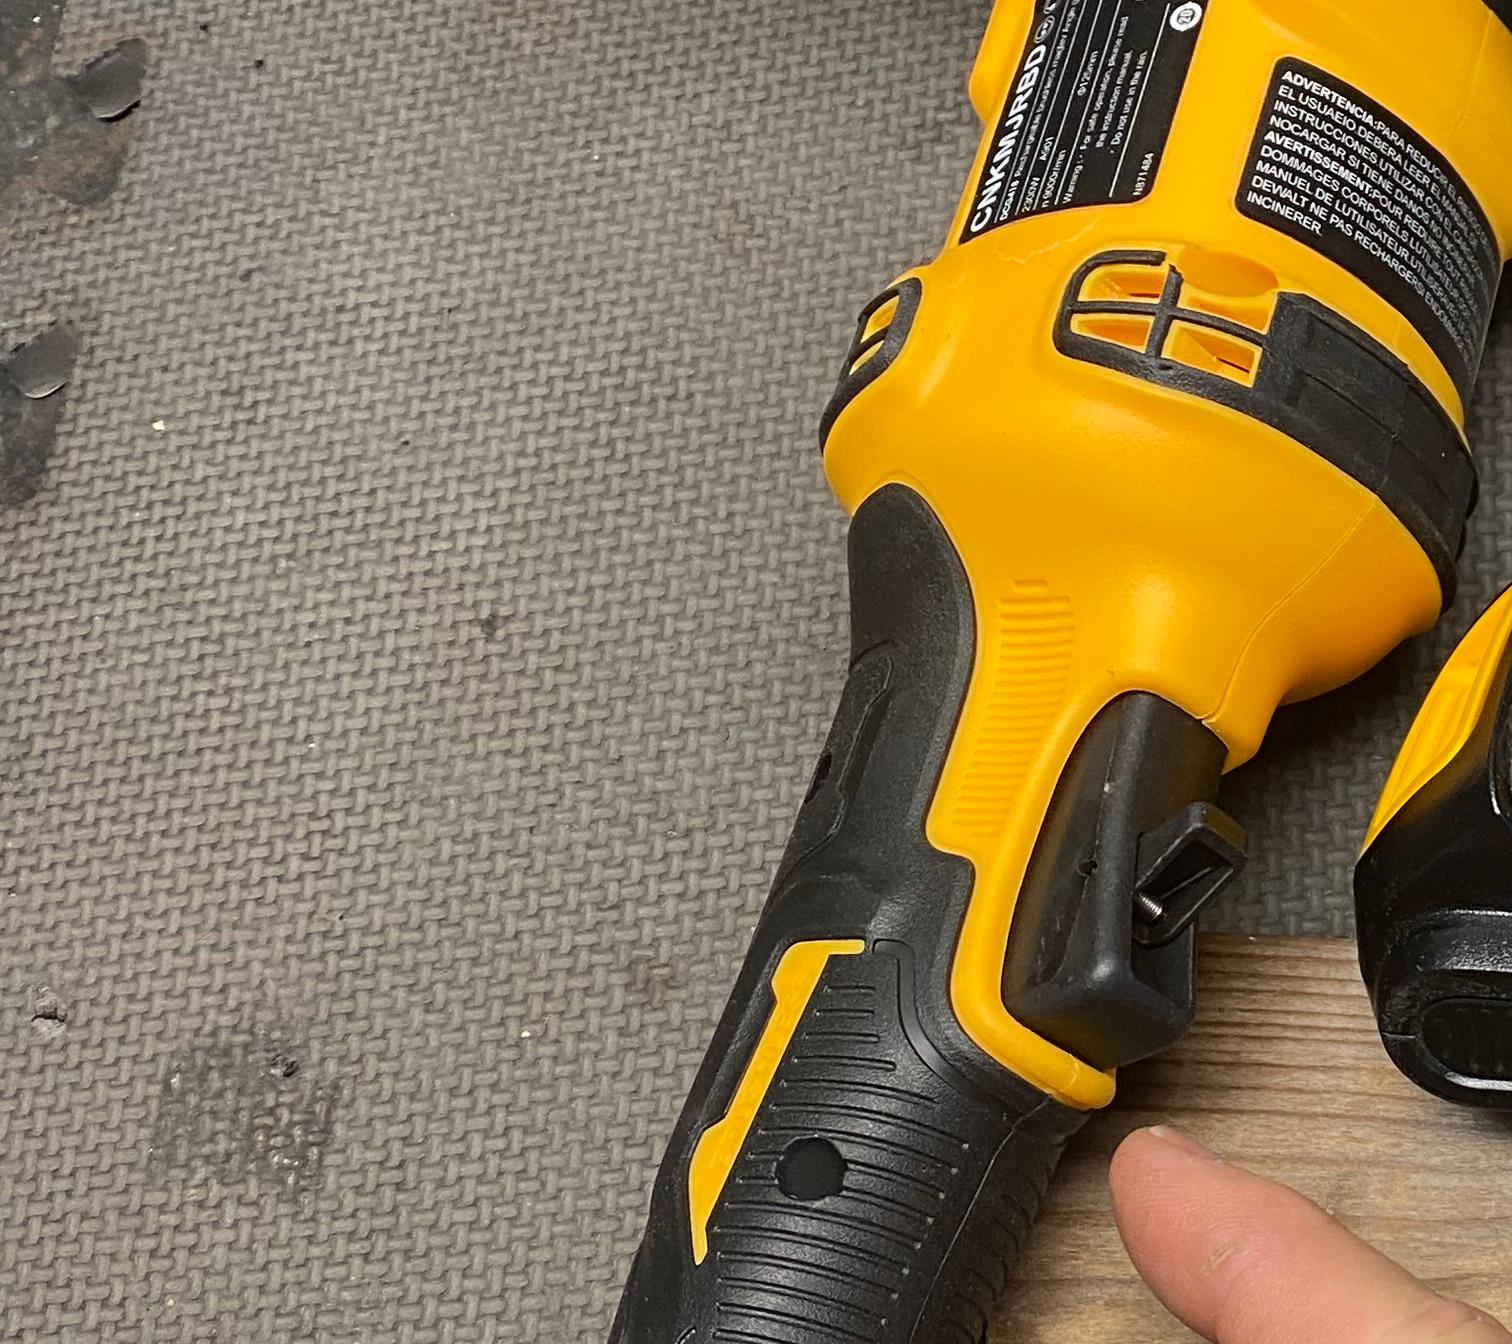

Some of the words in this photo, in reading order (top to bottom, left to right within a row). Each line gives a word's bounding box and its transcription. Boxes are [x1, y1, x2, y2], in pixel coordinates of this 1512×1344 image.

[970, 44, 1046, 232] CNKMJRBD
[1278, 85, 1295, 101] EL
[1357, 125, 1401, 166] DEBERA
[1251, 175, 1309, 207] DEWALT
[1309, 202, 1329, 221] NE
[1329, 213, 1353, 236] PAS
[1256, 160, 1313, 195] MANUEL
[1314, 187, 1334, 206] DE
[1260, 145, 1340, 191] DOMMAGES
[1341, 186, 1409, 242] CORPORELS
[1347, 155, 1360, 169] SI
[1362, 162, 1394, 194] TIENE
